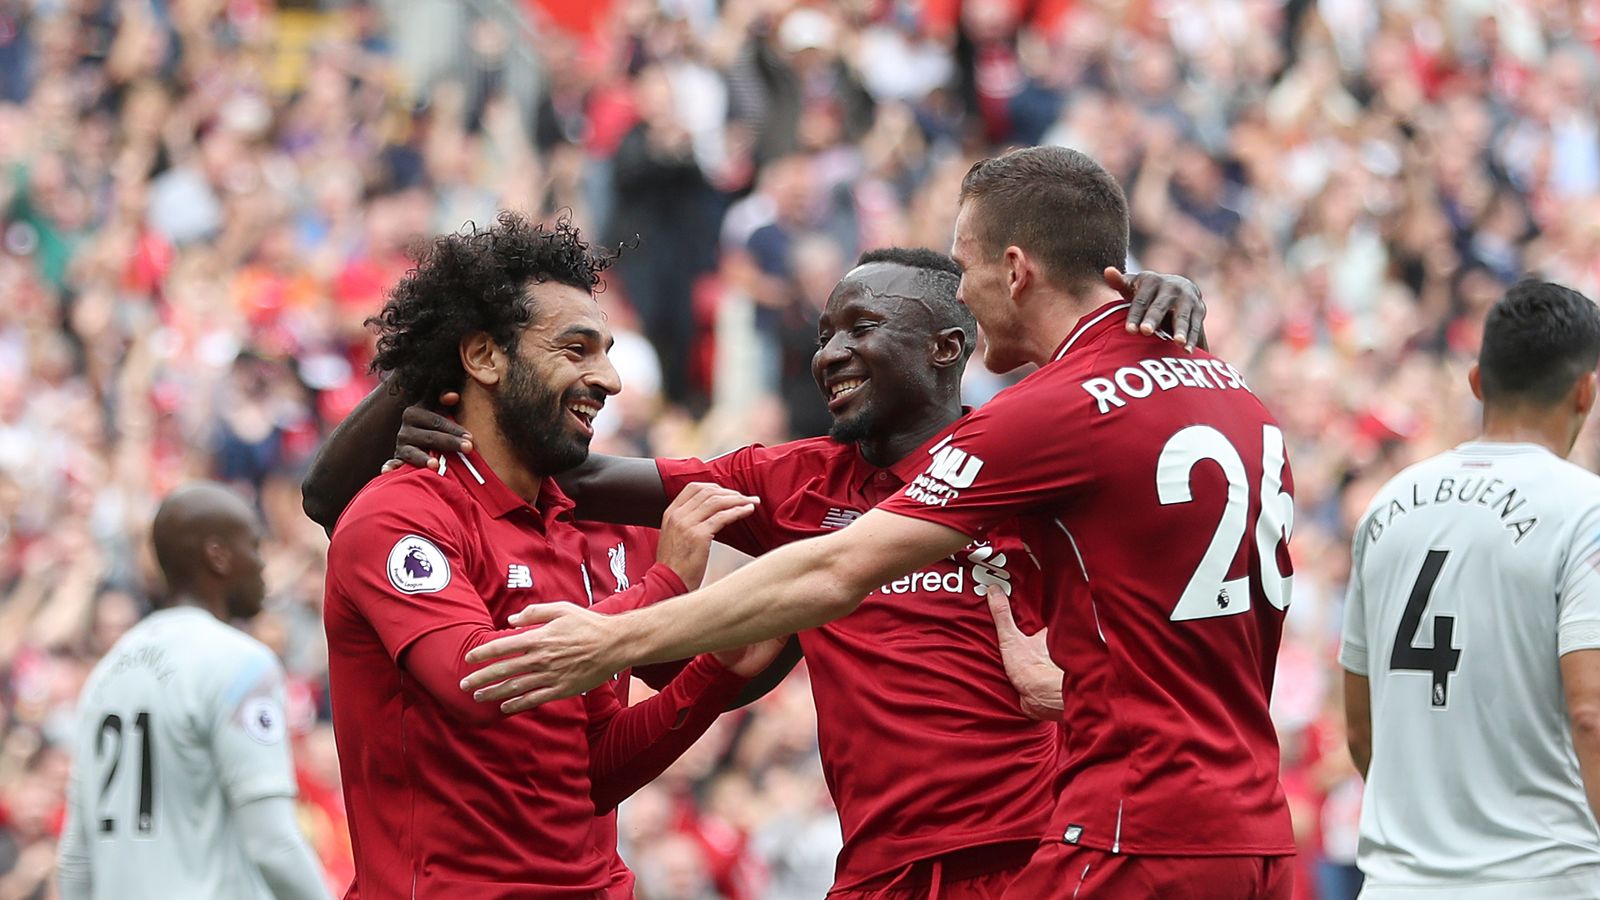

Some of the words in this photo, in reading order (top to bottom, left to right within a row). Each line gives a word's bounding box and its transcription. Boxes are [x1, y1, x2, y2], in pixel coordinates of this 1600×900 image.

[1156, 424, 1294, 620] 26
[1368, 477, 1537, 544] BALBUENA
[1389, 550, 1462, 706] 4
[97, 712, 153, 832] 21
